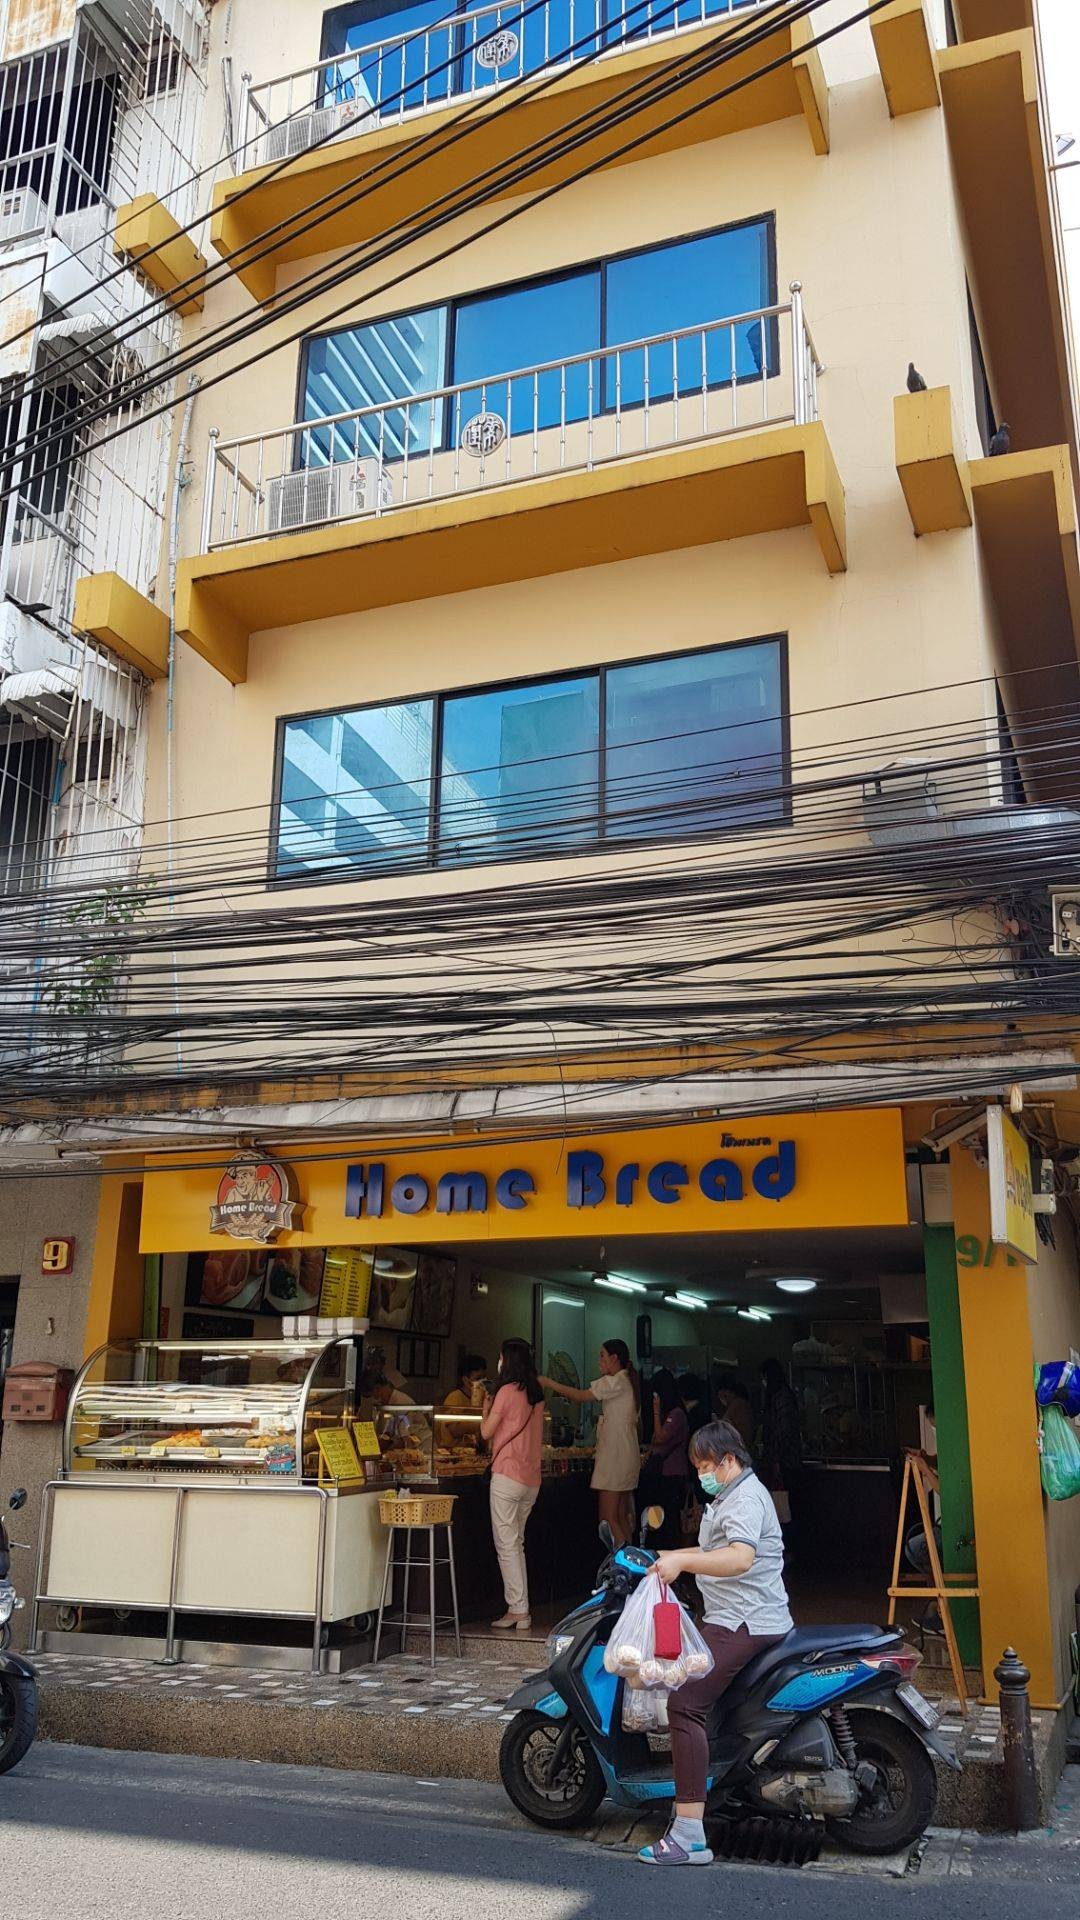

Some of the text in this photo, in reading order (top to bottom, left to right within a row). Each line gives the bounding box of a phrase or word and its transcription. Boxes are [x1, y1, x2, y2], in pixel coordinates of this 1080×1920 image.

[344, 1139, 796, 1218] Home Bread
[220, 1202, 277, 1215] Home Bread
[43, 1240, 69, 1271] 9
[957, 1235, 1018, 1268] 9/
[811, 1663, 858, 1677] MOOVE
